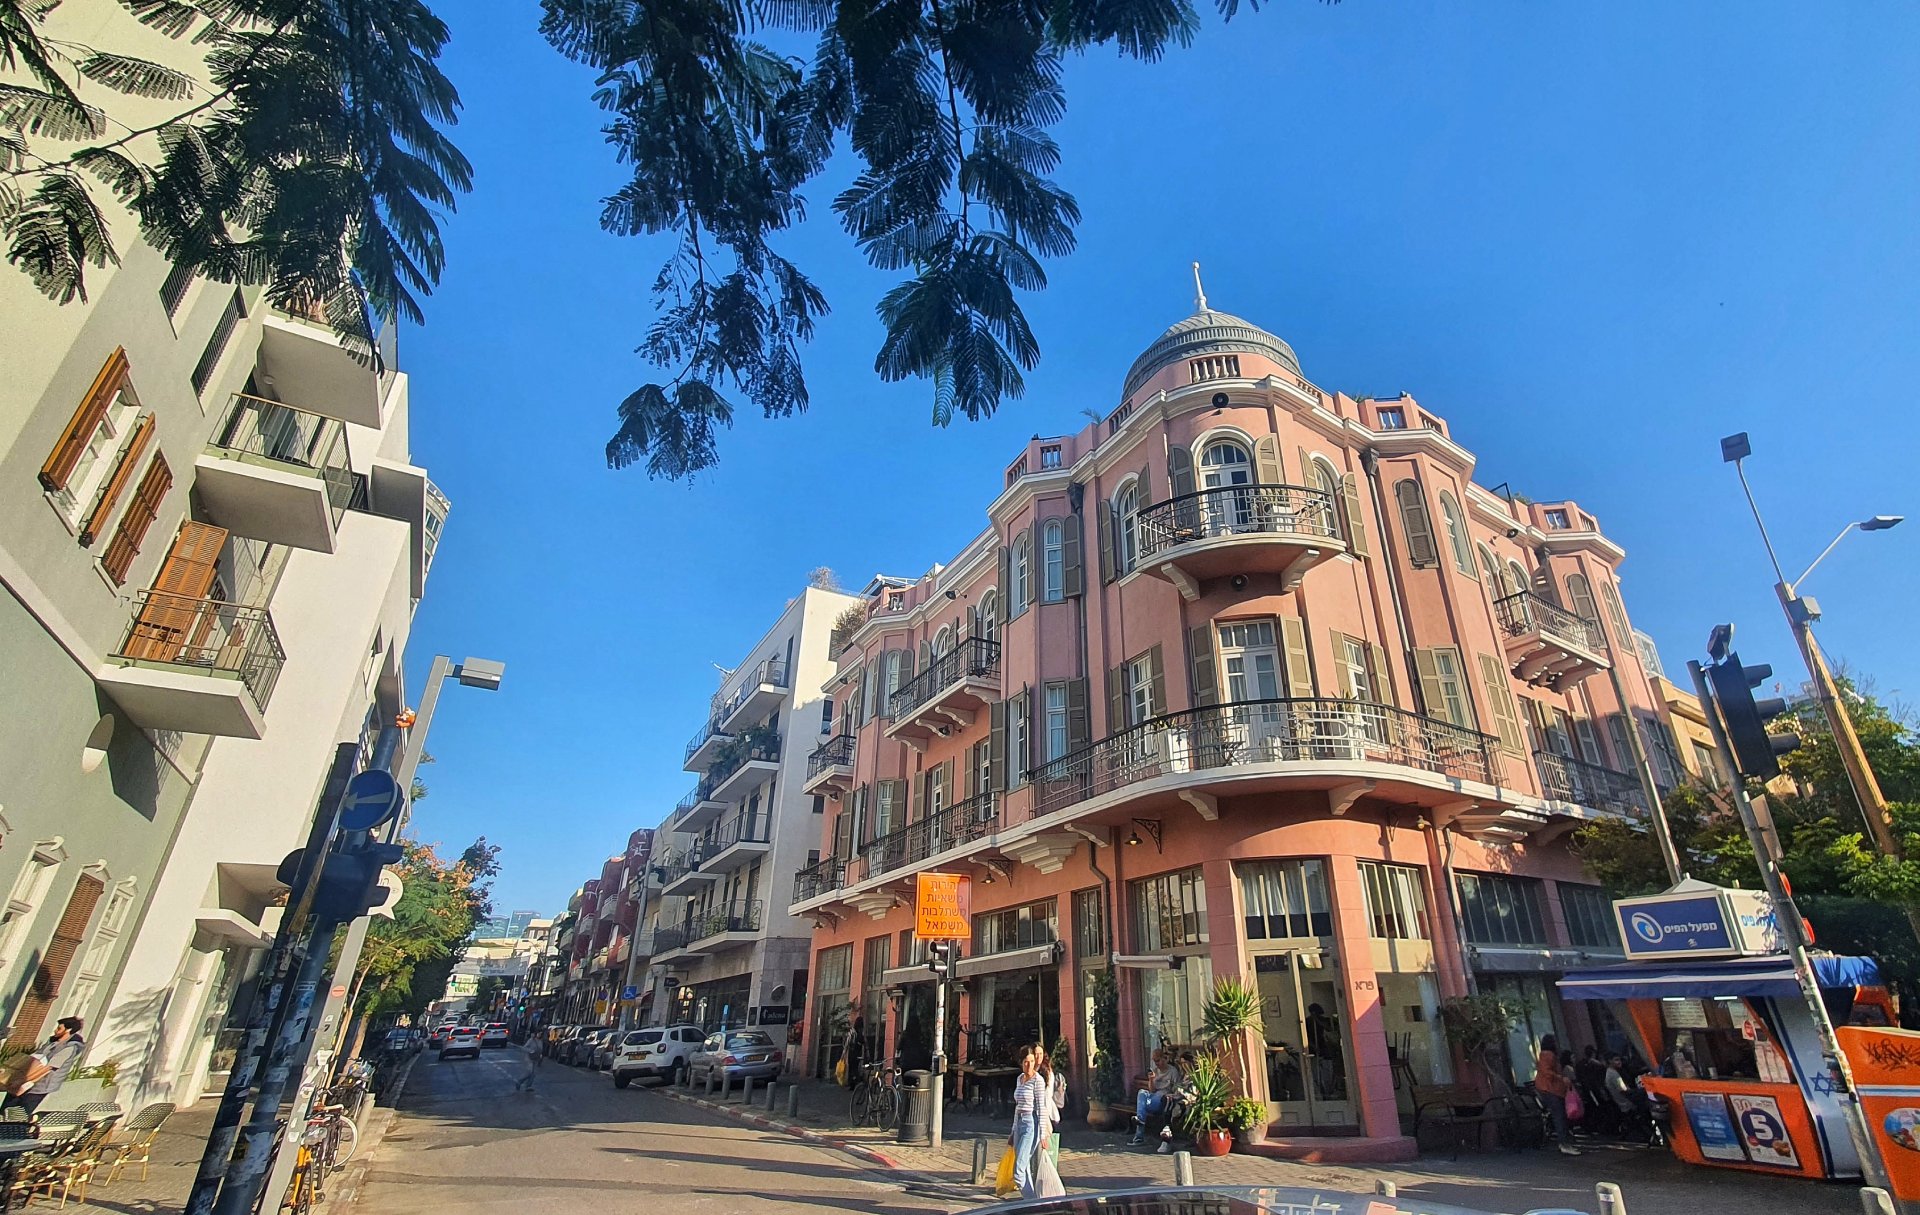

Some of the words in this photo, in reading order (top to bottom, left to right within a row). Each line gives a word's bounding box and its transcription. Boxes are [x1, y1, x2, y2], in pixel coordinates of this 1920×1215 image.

[930, 880, 960, 890] הירות
[926, 919, 963, 930] משמאל
[1663, 923, 1688, 935] הפיס
[1688, 921, 1718, 933] מפעל
[1354, 980, 1375, 991] פרא
[1749, 1113, 1774, 1141] 5
